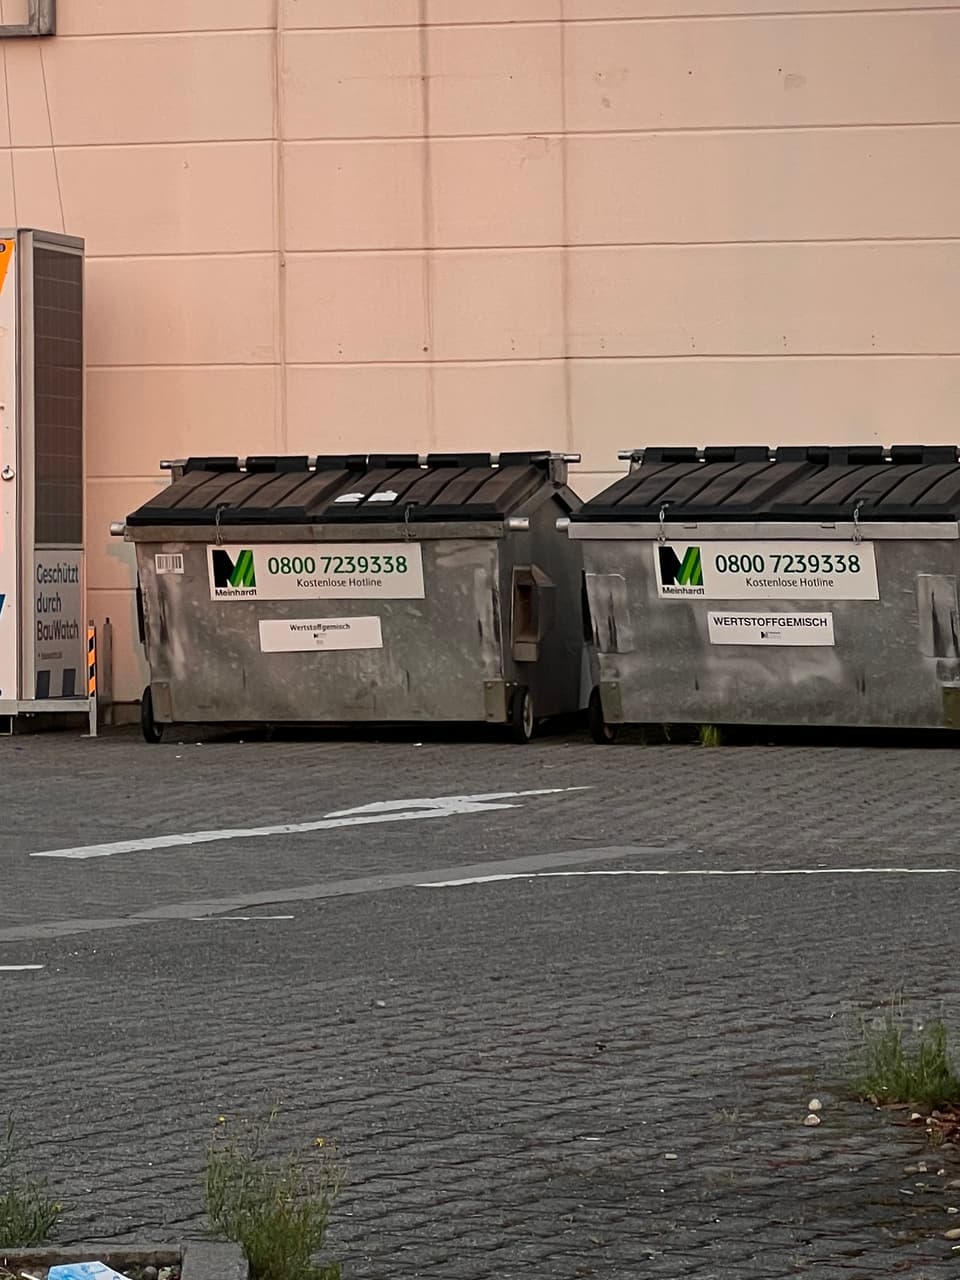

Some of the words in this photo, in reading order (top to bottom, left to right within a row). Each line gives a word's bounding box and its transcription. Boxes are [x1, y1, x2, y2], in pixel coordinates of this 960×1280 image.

[268, 557, 316, 575] 0800
[320, 556, 408, 575] 7239338
[715, 555, 765, 573] 0800
[769, 554, 860, 573] 7239338
[36, 562, 79, 584] Geschützt
[296, 578, 347, 588] Kostenlose
[348, 578, 383, 588] Hotline
[745, 577, 798, 588] Kostenlose
[799, 577, 834, 588] Hotline
[215, 588, 257, 597] Meinhardt
[662, 586, 705, 595] Meinhardt
[36, 591, 62, 613] durch
[713, 616, 828, 627] WERTSTOFFGEMISCH
[36, 619, 79, 641] BauWatch
[289, 623, 351, 632] Wertstoffgemisch
